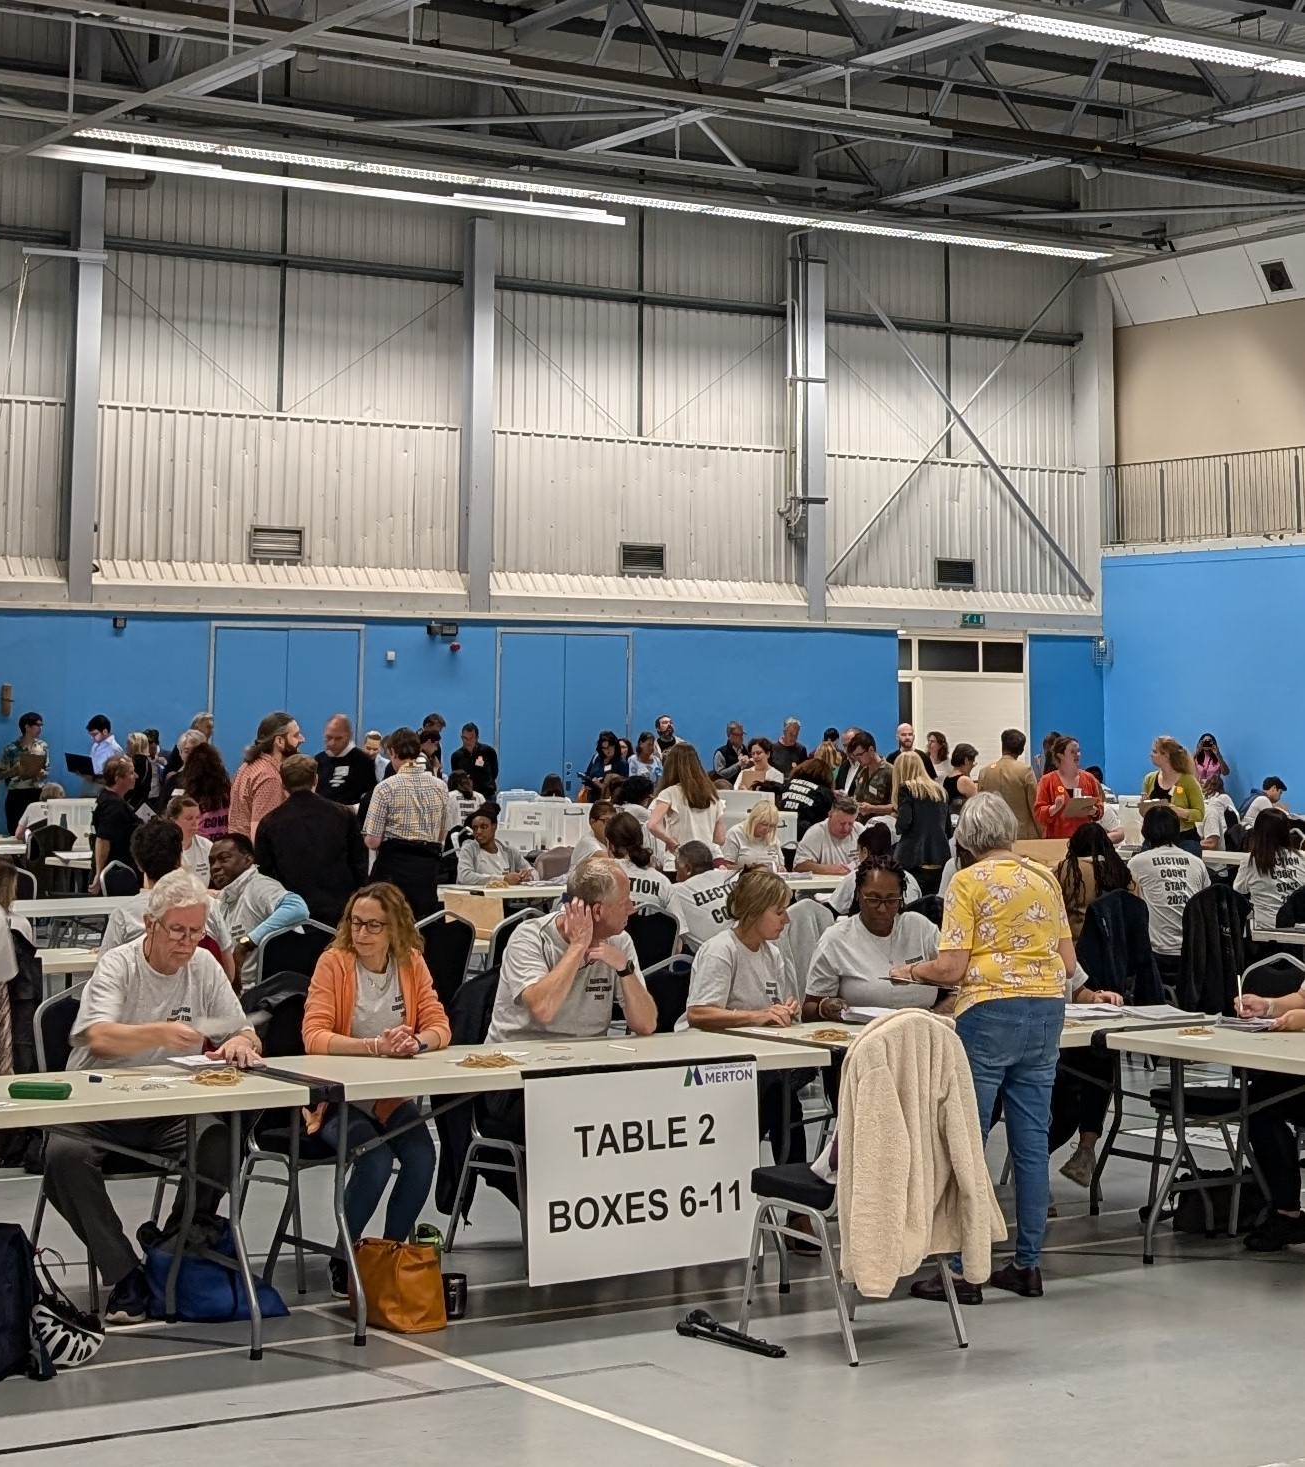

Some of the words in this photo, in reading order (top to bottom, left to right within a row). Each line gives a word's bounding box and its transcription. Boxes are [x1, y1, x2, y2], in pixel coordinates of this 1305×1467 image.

[1152, 856, 1191, 867] ELECTION
[1160, 869, 1188, 879] COUNT
[628, 877, 660, 897] TION
[1164, 881, 1188, 892] STAFF
[705, 1069, 753, 1084] MERTON
[574, 1116, 688, 1158] TABLE
[698, 1114, 715, 1146] 2
[549, 1189, 669, 1234] BOXES
[680, 1180, 741, 1217] 6-11
